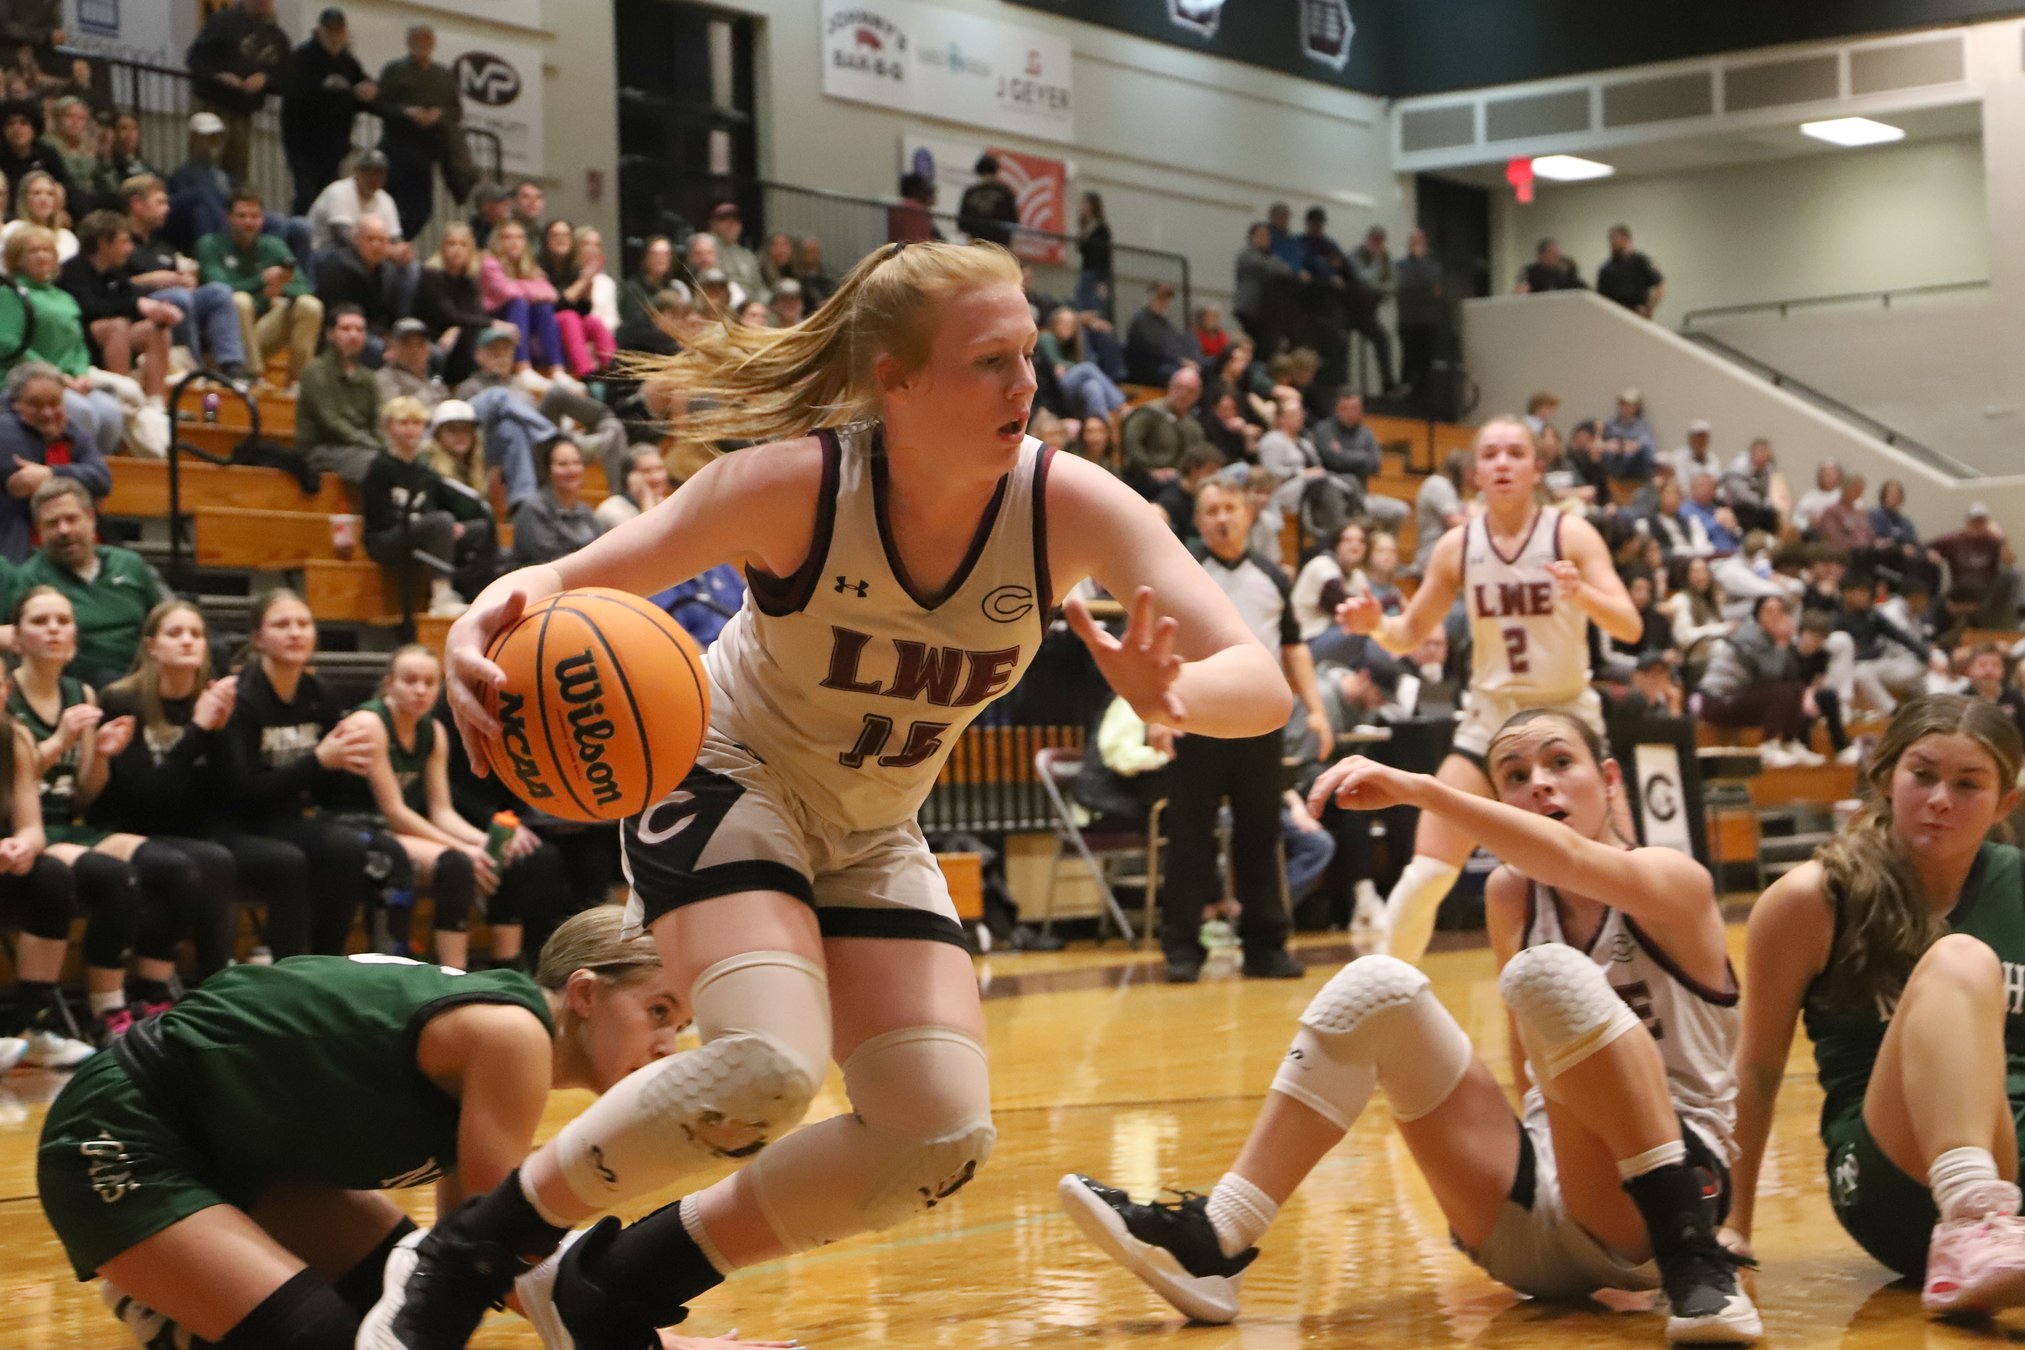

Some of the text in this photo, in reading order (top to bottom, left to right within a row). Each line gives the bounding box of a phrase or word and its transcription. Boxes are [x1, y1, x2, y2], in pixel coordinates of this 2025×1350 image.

[1474, 581, 1553, 618] LWE
[819, 625, 1021, 707] LWE
[1503, 627, 1530, 673] 2
[499, 690, 556, 798] NCAA
[555, 647, 623, 806] Wilson
[838, 712, 952, 769] 15
